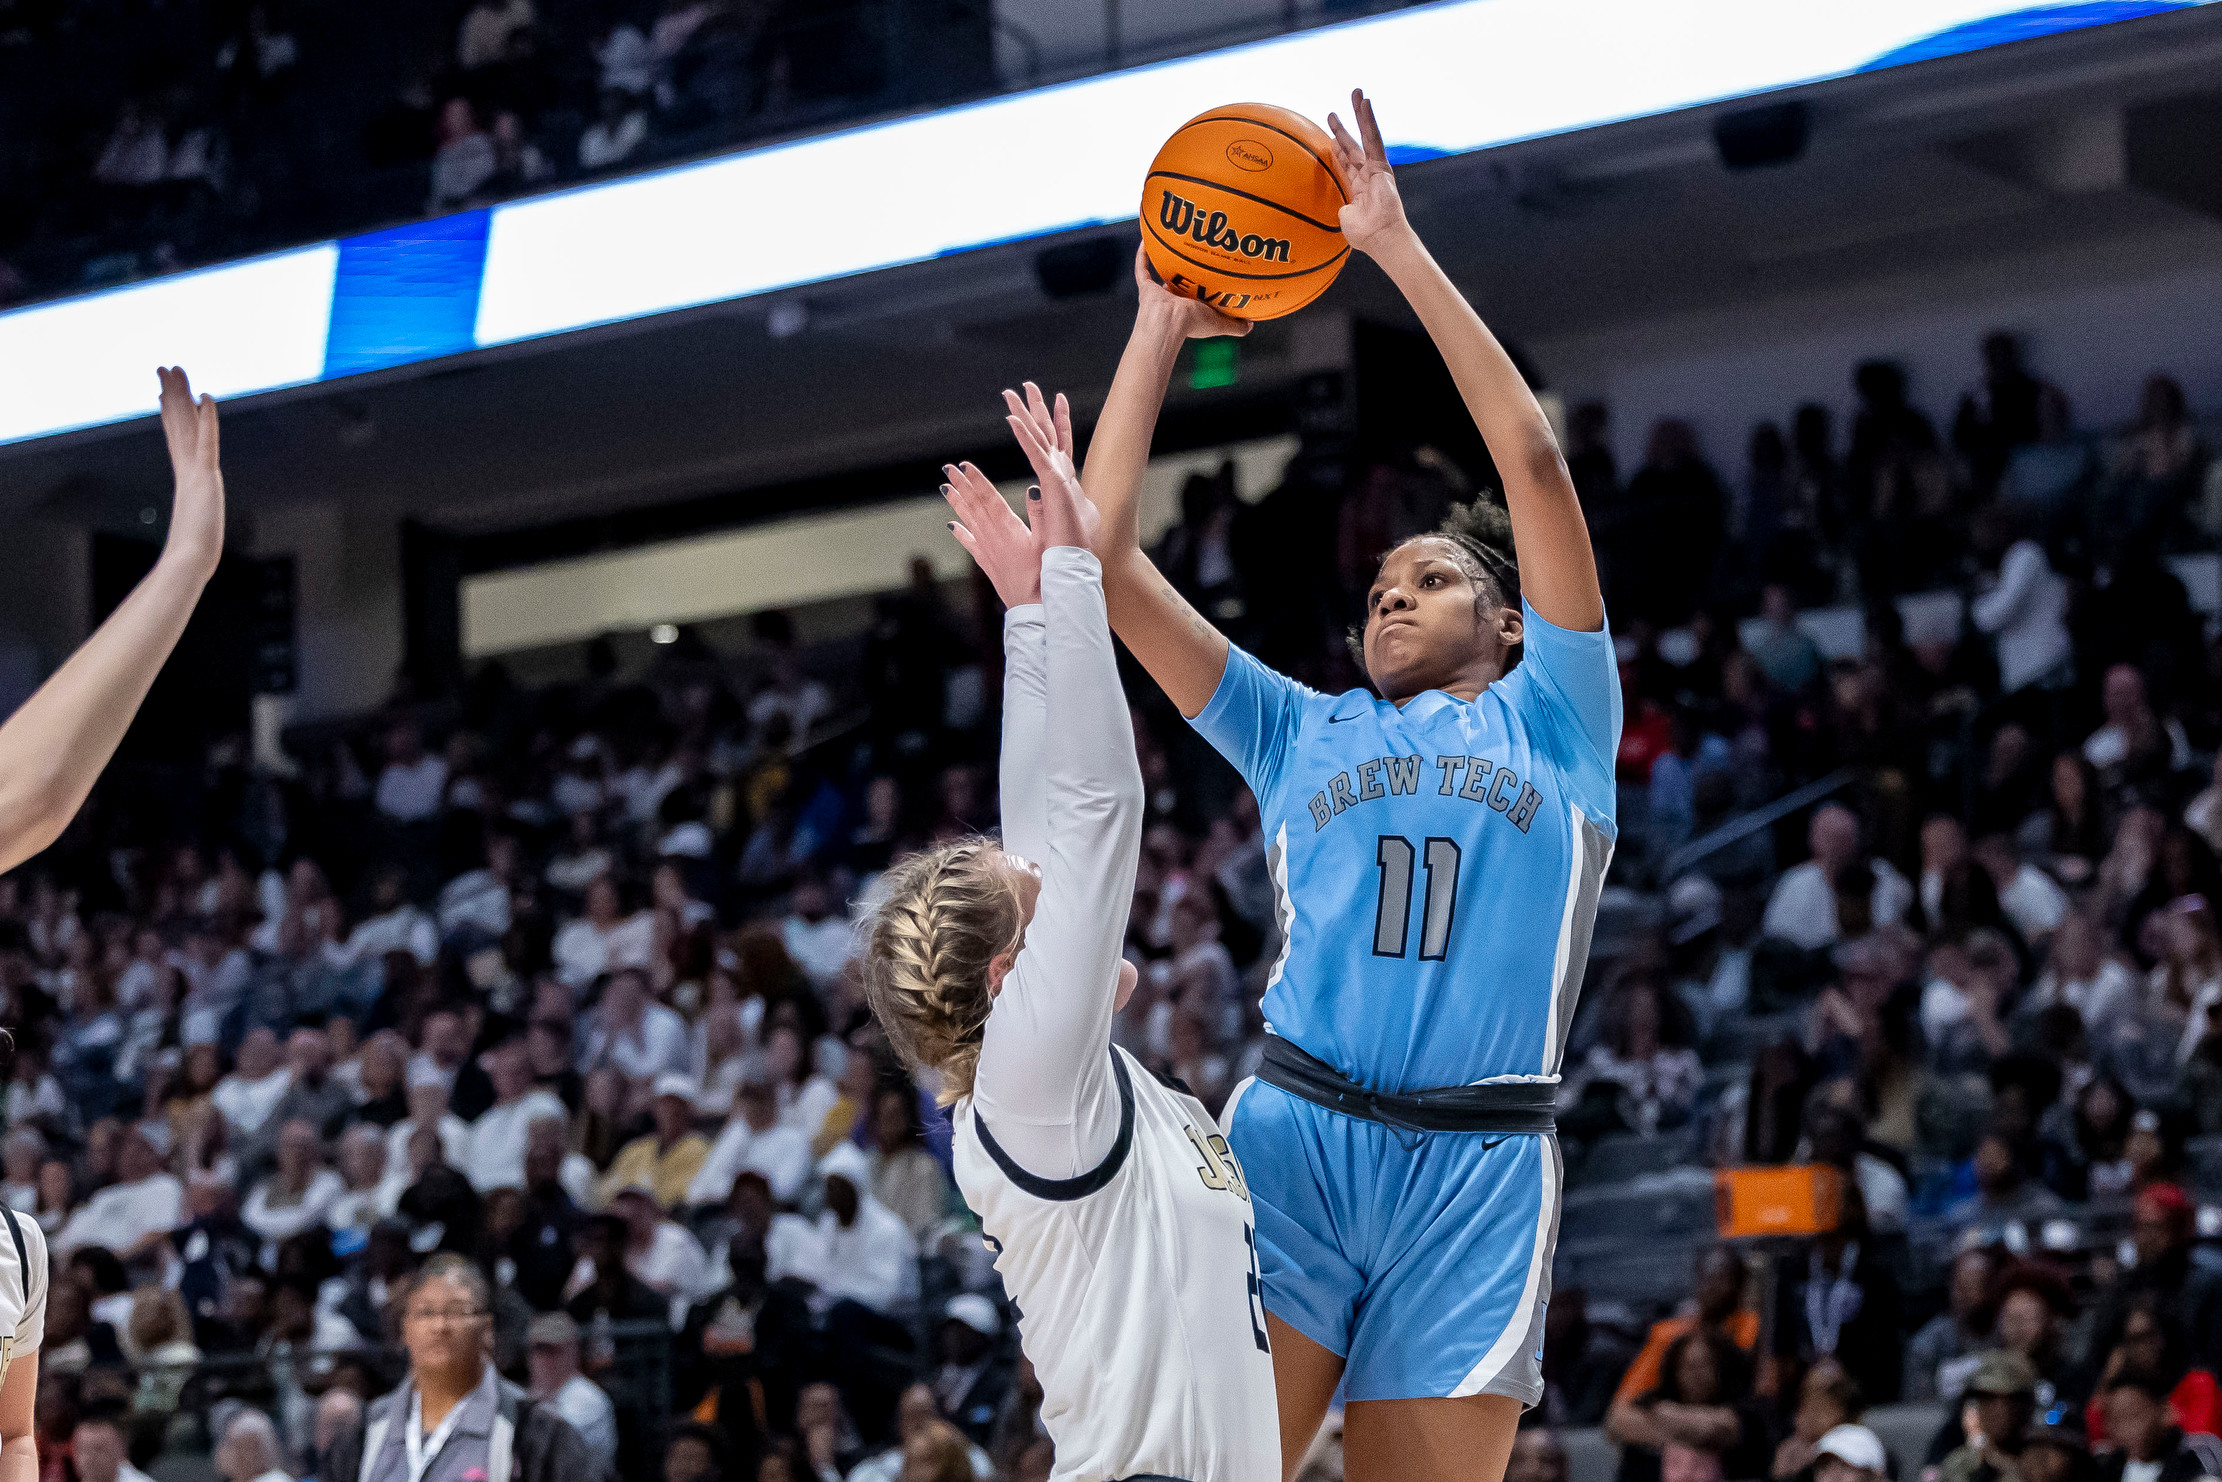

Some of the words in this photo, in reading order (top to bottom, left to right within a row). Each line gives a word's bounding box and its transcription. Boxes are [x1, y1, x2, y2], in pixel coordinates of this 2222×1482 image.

[1160, 189, 1292, 263] Wilson
[1171, 273, 1251, 309] EVO
[1253, 291, 1280, 302] NXT
[1308, 754, 1424, 833] BREW
[1437, 755, 1543, 835] TECH
[1372, 834, 1462, 962] 11
